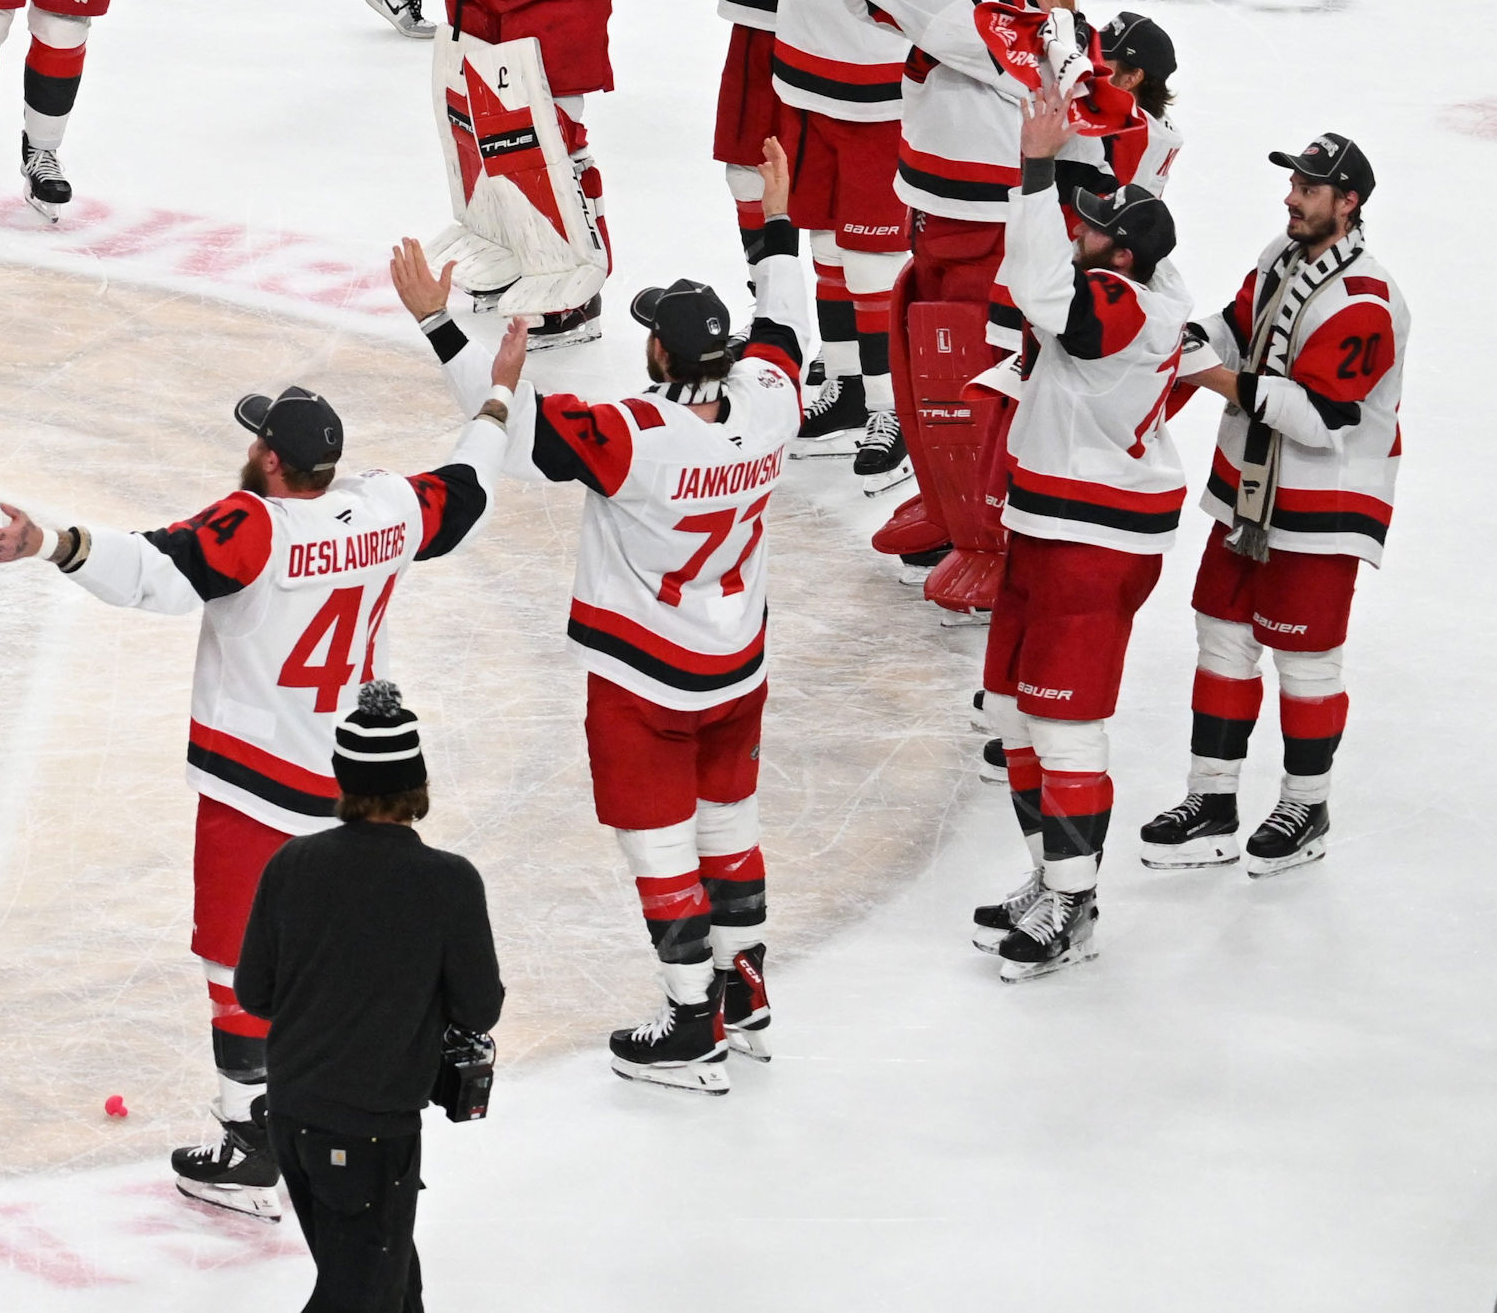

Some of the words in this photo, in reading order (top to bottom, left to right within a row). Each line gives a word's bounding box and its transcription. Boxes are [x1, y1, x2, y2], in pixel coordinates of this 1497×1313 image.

[481, 133, 533, 152] TRUE
[843, 223, 900, 236] BAUER
[1338, 332, 1382, 379] 20
[918, 409, 971, 419] TRUE
[670, 442, 785, 502] JANKOWSKI
[287, 521, 406, 579] DESLAURIERS
[657, 490, 773, 607] 77
[1252, 611, 1308, 635] BAUER
[1017, 681, 1074, 701] BAUER
